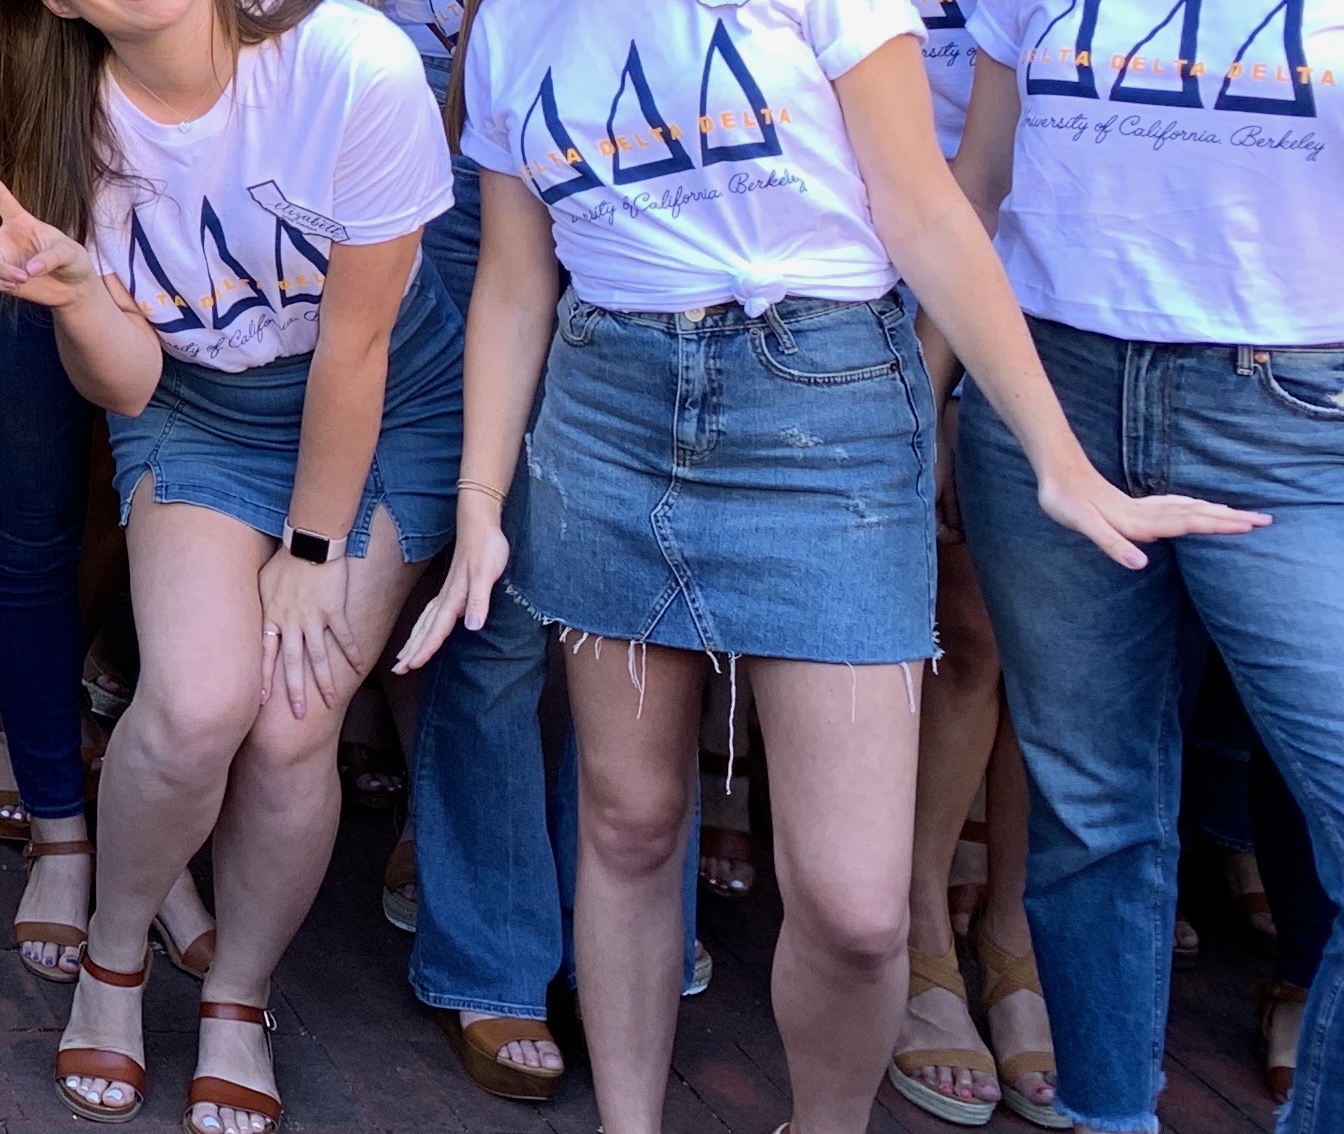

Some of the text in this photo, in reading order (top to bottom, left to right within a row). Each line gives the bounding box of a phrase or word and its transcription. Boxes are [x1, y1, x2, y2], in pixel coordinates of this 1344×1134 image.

[922, 42, 959, 67] rsity
[1109, 52, 1206, 77] DELTA
[1226, 61, 1337, 87] DELTA
[598, 123, 683, 157] DELTA
[699, 107, 791, 134] DELTA
[1094, 114, 1119, 144] of
[1230, 125, 1327, 162] Berkeley
[206, 336, 225, 359] of
